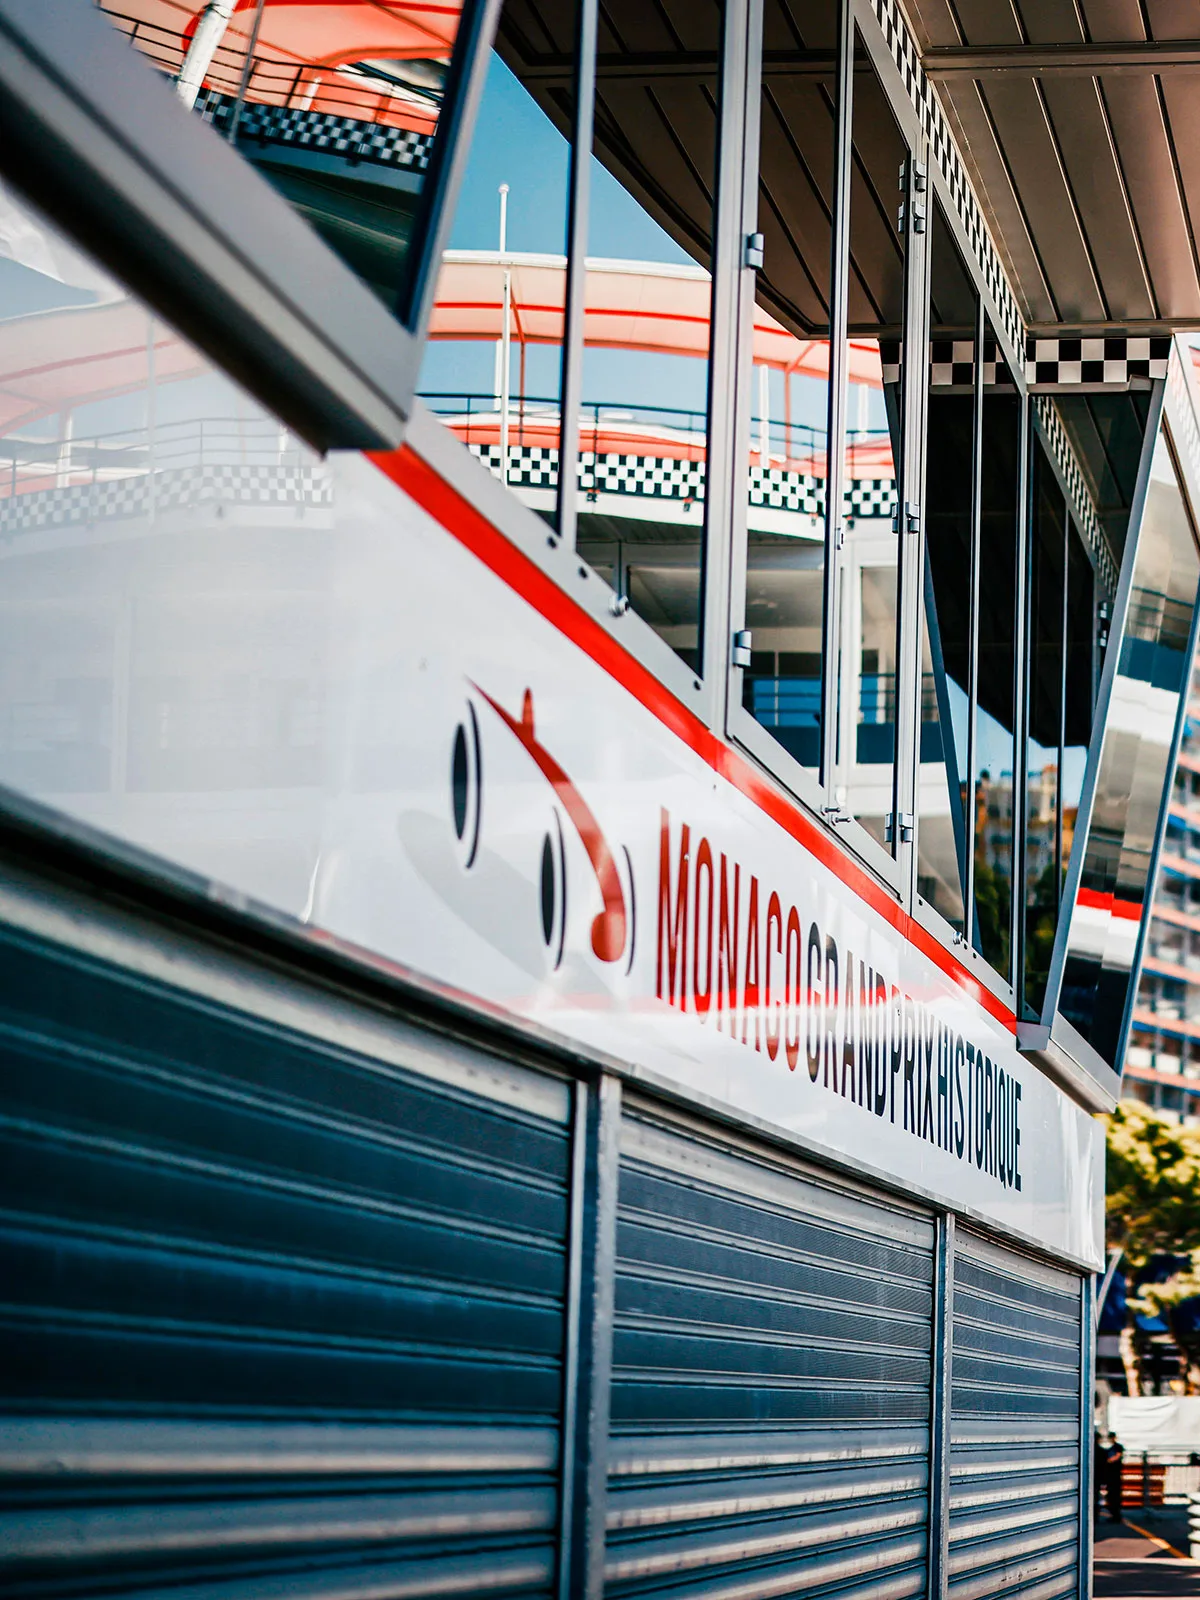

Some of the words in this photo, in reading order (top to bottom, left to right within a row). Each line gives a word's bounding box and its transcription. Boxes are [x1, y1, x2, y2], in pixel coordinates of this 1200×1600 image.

[656, 805, 801, 1072] MONACO
[806, 921, 887, 1118] GRAND
[890, 984, 935, 1144] PRIX
[937, 1021, 1022, 1193] HISTORIQUE
